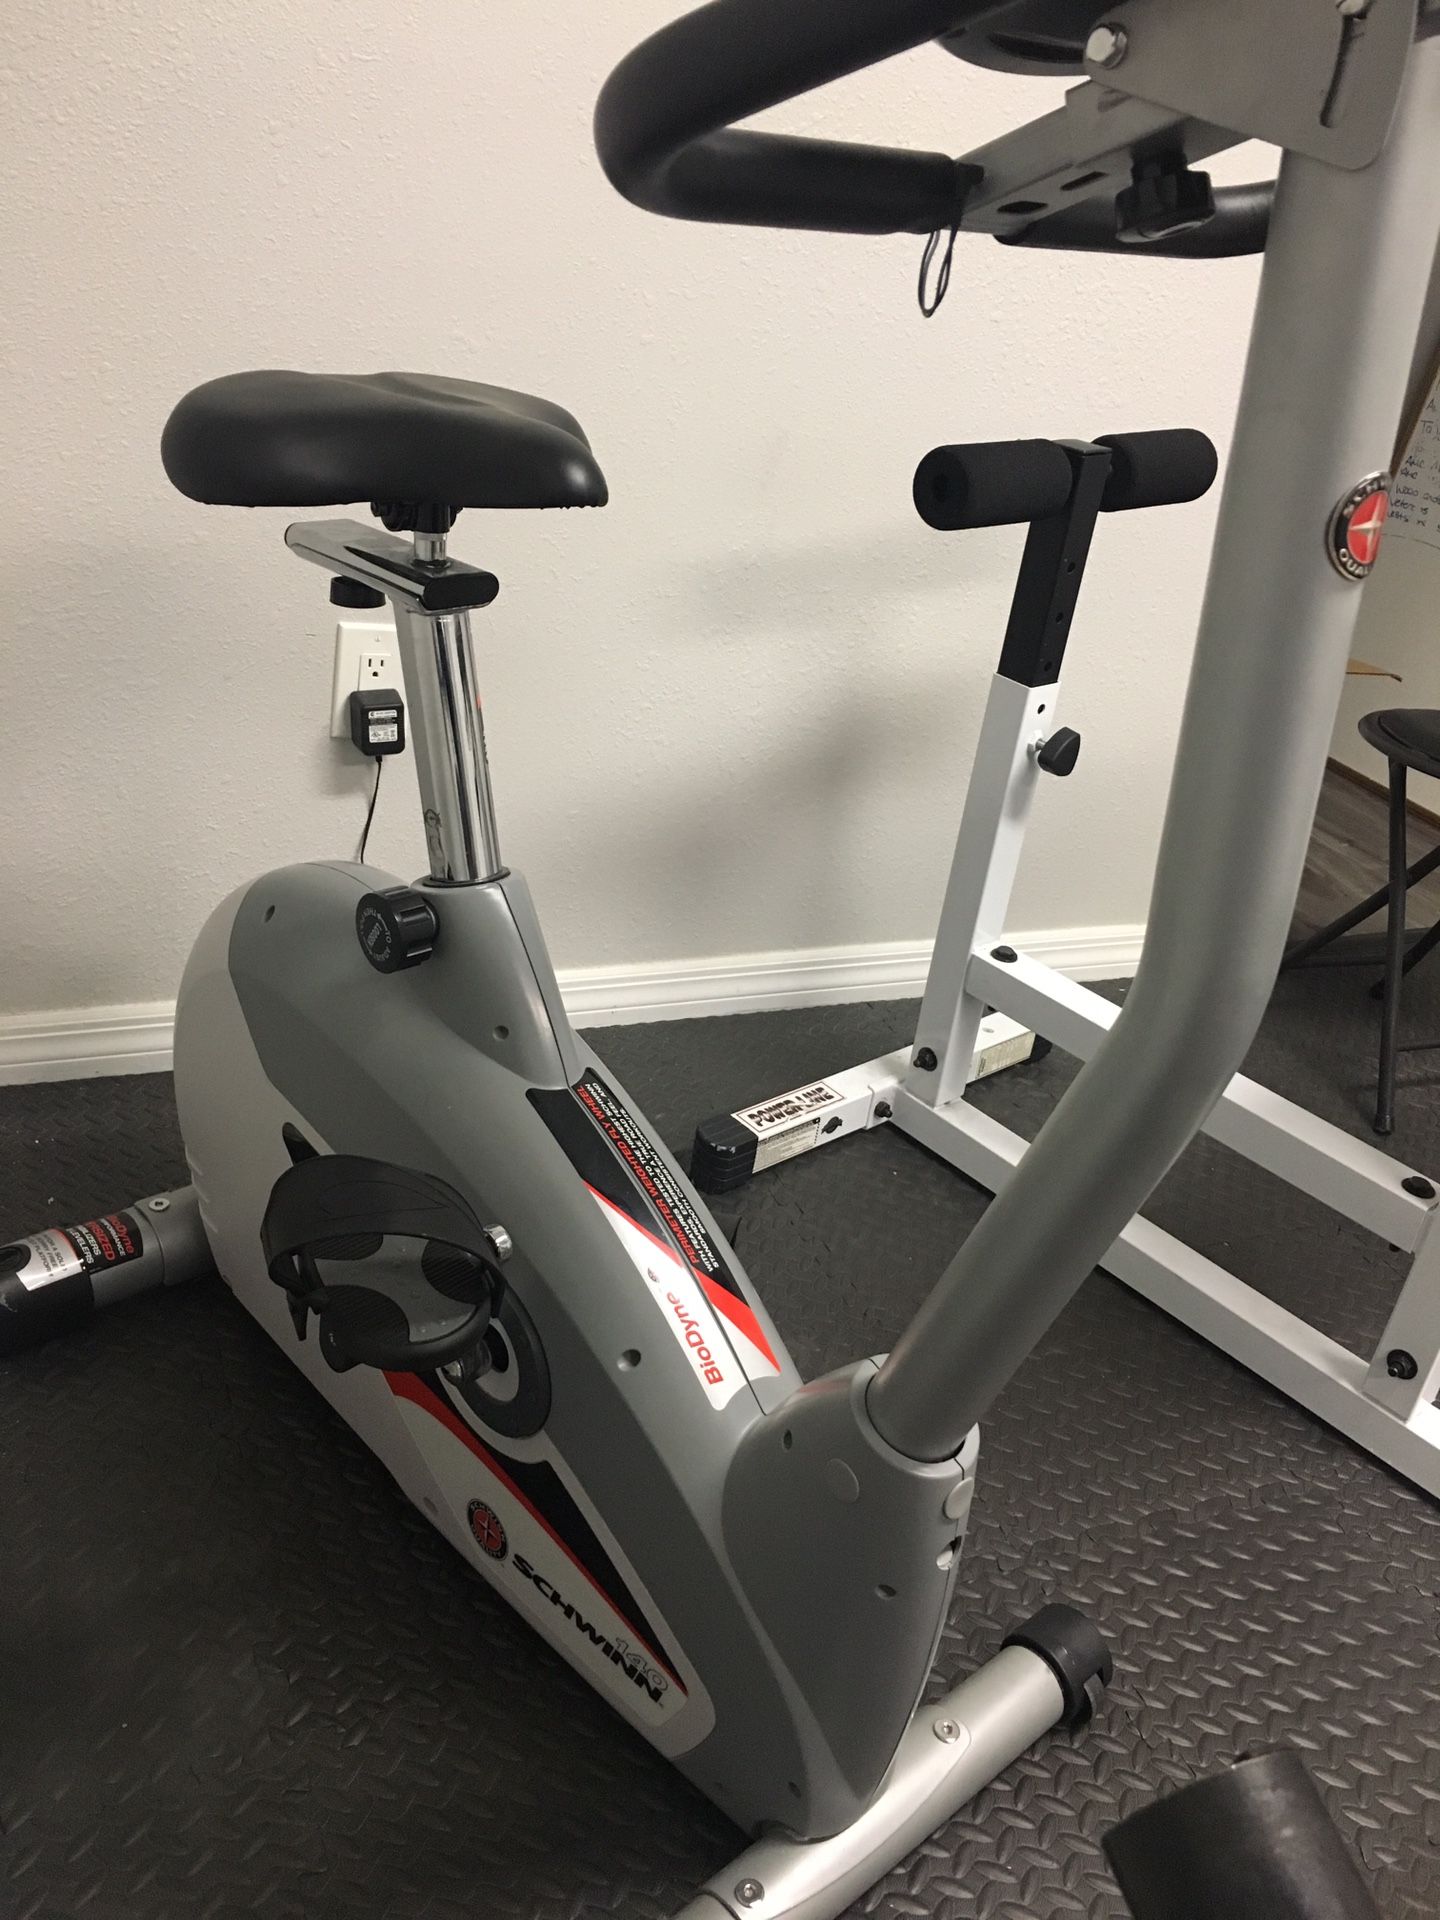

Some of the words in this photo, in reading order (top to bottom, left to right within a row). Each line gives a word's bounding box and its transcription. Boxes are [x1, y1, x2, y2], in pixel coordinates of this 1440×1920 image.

[576, 1084, 605, 1120] WHEEL
[584, 1083, 613, 1116] SCHWINN
[591, 1082, 607, 1098] AND
[601, 1121, 620, 1139] FLY
[609, 1116, 637, 1148] HIGHEST
[618, 1117, 637, 1139] ROAD
[632, 1149, 647, 1165] THE
[633, 1139, 651, 1159] TRUE
[648, 1159, 657, 1167] A
[617, 1139, 659, 1197] WEIGHTED
[643, 1164, 655, 1176] TO
[648, 1149, 685, 1197] CONSISTENT
[651, 1176, 675, 1207] TESTED
[652, 1166, 688, 1215] EXPERIENCE
[656, 1197, 700, 1263] PERIMETER
[671, 1207, 702, 1250] FEATURES
[680, 1198, 706, 1234] SMOOTH
[696, 1249, 714, 1272] WITH
[666, 1291, 724, 1385] BioDyne
[512, 1553, 664, 1704] SCHWINN
[616, 1637, 669, 1692] 140
